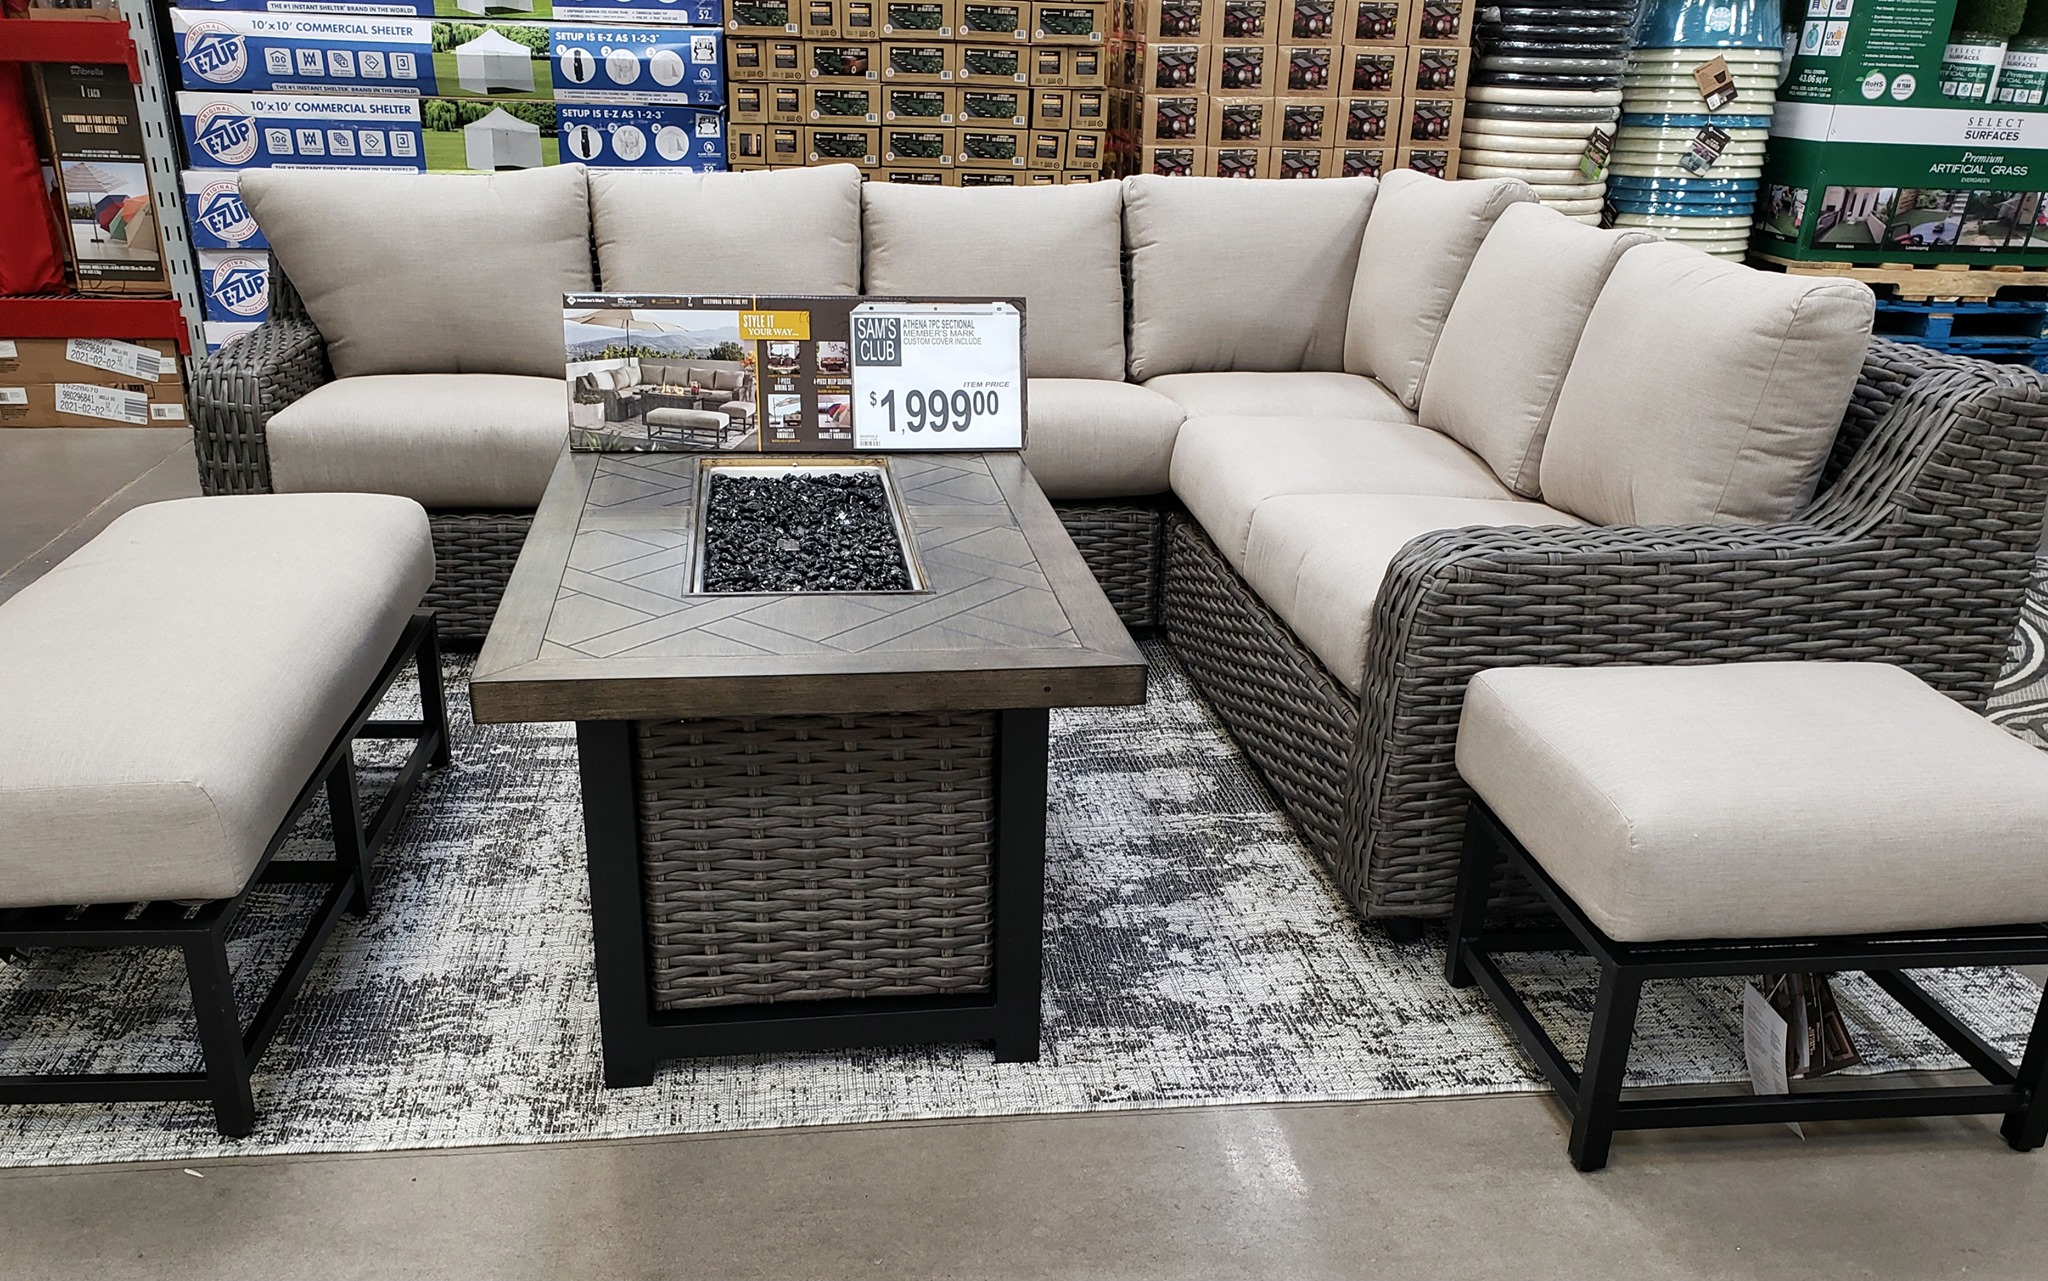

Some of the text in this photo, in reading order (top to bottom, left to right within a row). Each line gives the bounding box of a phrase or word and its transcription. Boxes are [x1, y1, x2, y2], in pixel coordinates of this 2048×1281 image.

[296, 22, 369, 35] COMMERCIAL
[371, 25, 413, 36] SHELTER
[555, 31, 584, 41] SETUP
[587, 33, 595, 42] IS
[597, 33, 613, 42] E-Z
[615, 33, 628, 43] AS
[1826, 31, 1835, 39] UV
[270, 55, 286, 63] 100
[400, 58, 406, 67] 3
[1865, 80, 1884, 88] RoHS
[87, 88, 101, 98] EACH
[294, 102, 367, 114] COMMERCIAL
[370, 104, 412, 115] SHELTER
[562, 108, 590, 117] SETUP
[592, 109, 601, 118] IS
[604, 109, 618, 118] E-Z
[621, 110, 634, 118] AS
[200, 105, 231, 124] ORIGINAL
[1967, 117, 2025, 128] SELECT
[271, 136, 287, 144] 100
[399, 137, 406, 145] 3
[1964, 130, 2020, 141] SURFACES
[1961, 152, 2004, 163] Premium
[1928, 163, 2028, 176] ARTIFICIAL GRASS
[743, 315, 774, 328] STYLE IT
[902, 320, 975, 330] ATHENA 7PC SECTIONAL
[748, 328, 772, 336] YOUR
[857, 318, 897, 339] SAM'S
[903, 337, 982, 346] CUSTOM COVER INCLUDE
[860, 340, 895, 361] CLUB
[70, 349, 117, 369] 2021-02-02
[60, 400, 105, 416] 2021-02-02
